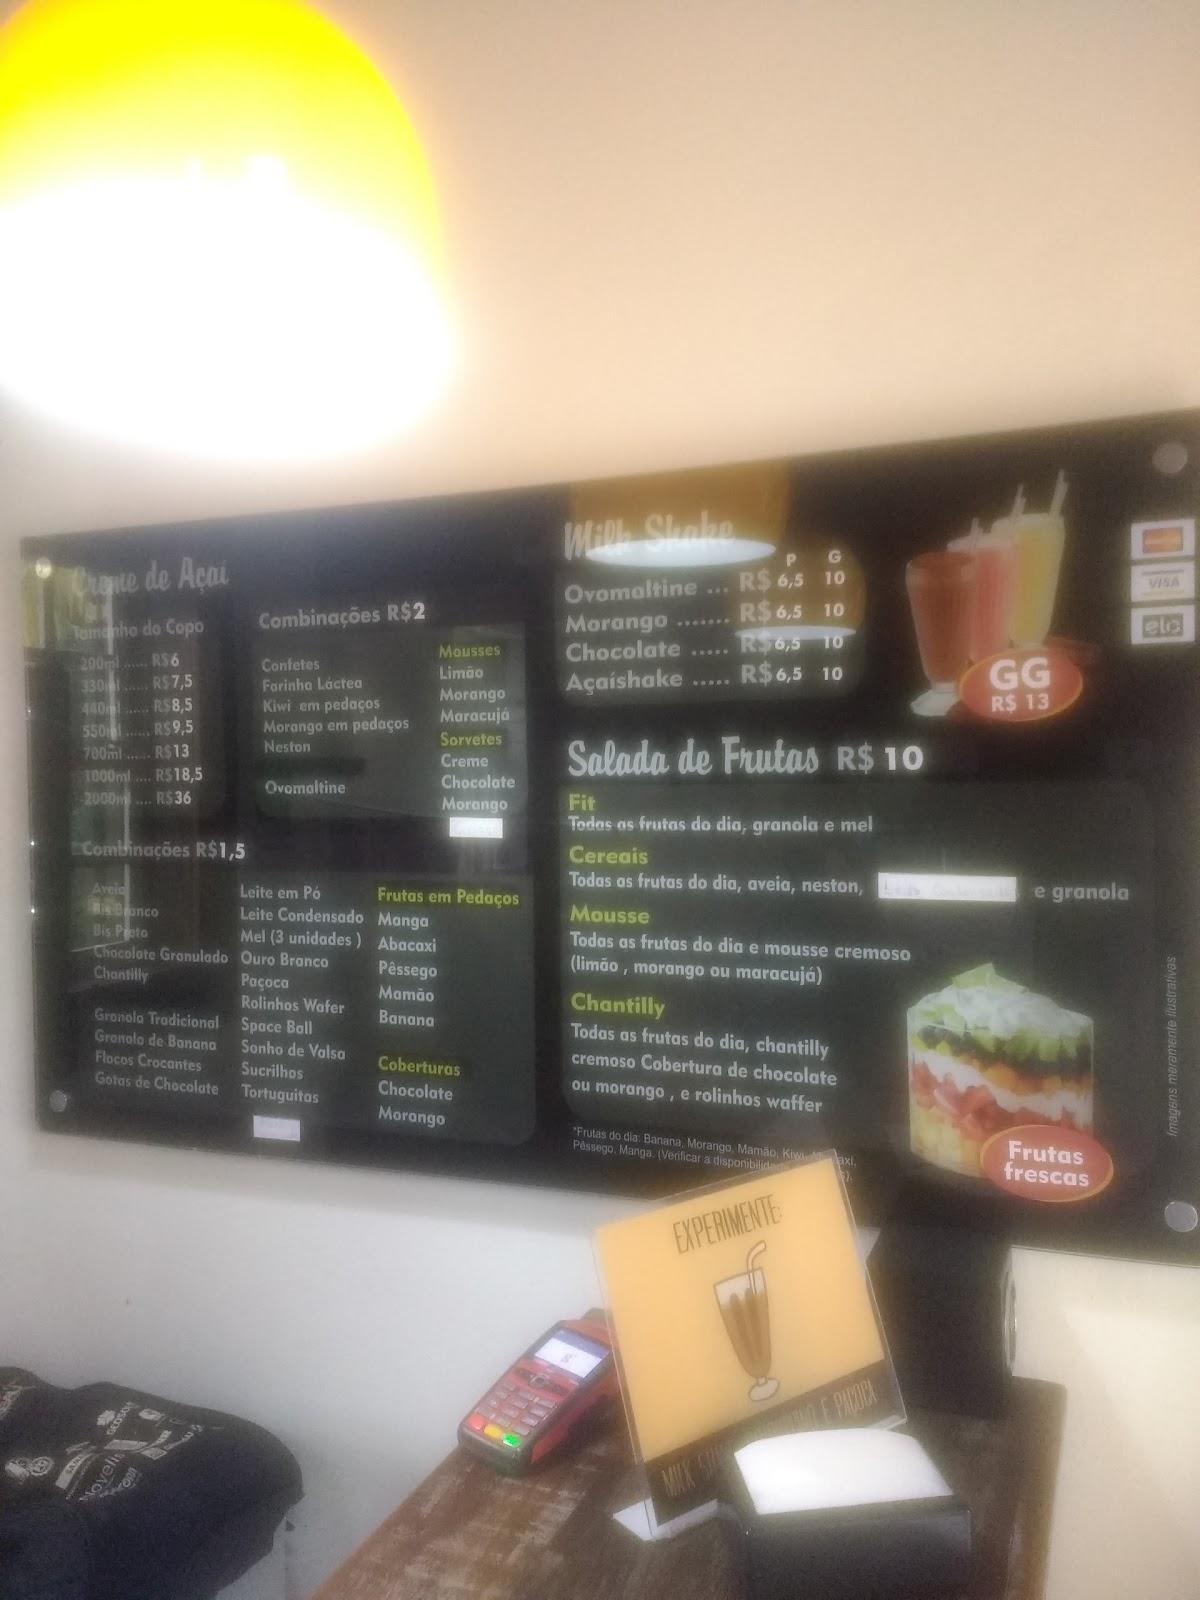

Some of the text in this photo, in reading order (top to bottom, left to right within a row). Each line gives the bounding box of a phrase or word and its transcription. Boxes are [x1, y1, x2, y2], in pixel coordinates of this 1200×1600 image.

[564, 511, 736, 560] Milk Shake
[145, 560, 171, 591] de
[1148, 577, 1180, 589] VISA
[564, 574, 804, 604] Ovomaltine 6,5
[258, 602, 425, 629] Combinações R$2
[565, 605, 802, 636] Morango 6,5
[71, 618, 204, 640] Tamanho do Copo
[439, 644, 501, 659] Mousses
[565, 638, 800, 662] Chocolate 6,5
[80, 653, 179, 671] 200ml R$6
[261, 659, 320, 673] Confetes
[439, 666, 484, 681] Limão
[565, 668, 802, 695] Açaíshake 6,5
[990, 657, 1050, 691] GG
[80, 674, 193, 694] 330ml R$7,5
[262, 677, 313, 693] Farinha
[440, 688, 506, 702] Morango
[991, 693, 1049, 714] R$ 13
[154, 698, 193, 714] R$8,5
[263, 697, 380, 714] Kiwi pedaços
[440, 709, 510, 724] Maracujá
[82, 720, 193, 738] 550ml R$9,5
[264, 718, 409, 735] Morango pedaços
[264, 740, 311, 753] Neston
[440, 732, 502, 746] Sorvetes
[83, 744, 189, 760] 700ml R$13
[441, 753, 489, 768] Creme
[568, 736, 923, 777] Salada Frutas 10
[83, 767, 203, 783] 1000ml R$18,5
[441, 775, 516, 789] Chocolate
[265, 780, 346, 795] Ovomaltine
[156, 790, 191, 805] R$36
[442, 797, 508, 812] Morango
[569, 794, 596, 812] Fit
[568, 815, 873, 836] Todas frutas do dia, granola mel
[82, 840, 245, 862] Combinações R$1,5
[570, 846, 648, 864] Cereais
[241, 885, 273, 899] Leite
[569, 871, 612, 889] Todas
[638, 872, 683, 890] frutas
[713, 874, 742, 893] dia,
[748, 874, 796, 895] aveia,
[802, 876, 864, 897] neston,
[1052, 882, 1129, 903] granola
[378, 887, 520, 908] Frutas Pedaços
[241, 907, 364, 924] Leite Condensado
[378, 913, 429, 930] Manga
[570, 904, 649, 924] Mousse
[94, 924, 111, 937] Bis
[241, 929, 352, 946] Mel unidades
[378, 937, 436, 953] Abacaxi
[570, 931, 911, 961] Todas frutas dia mousse cremoso
[94, 946, 228, 964] Chocolate Granulado
[241, 951, 329, 968] Ouro Branco
[94, 965, 149, 984] Chantilly
[379, 960, 438, 979] Pêssego
[570, 956, 823, 986] (limão morango ou maracujá)
[241, 974, 289, 991] Paçoca
[379, 985, 434, 1002] Mamão
[241, 995, 345, 1014] Rolinhos Wafer
[570, 992, 665, 1020] Chantilly
[95, 1008, 219, 1029] Granola Tradicional
[241, 1017, 312, 1035] Space Ball
[379, 1010, 435, 1027] Banana
[95, 1029, 217, 1051] Granola de Banana
[571, 1023, 829, 1061] Todas frutas do dia, chantilly
[1166, 956, 1180, 1137] Imagens meramente ilustrativas
[241, 1040, 346, 1060] Sonho Valsa
[95, 1051, 202, 1072] Flocos Crocantes
[241, 1062, 304, 1080] Sucrilhos
[378, 1056, 461, 1076] Coberturas
[572, 1053, 837, 1086] cremoso Cobertura de chocolate
[95, 1072, 219, 1095] Gotas Chocolate
[378, 1080, 453, 1101] Chocolate
[242, 1084, 319, 1104] Tortuguitas
[595, 1081, 823, 1113] morango rolinhos waffer
[379, 1105, 446, 1127] Morango
[657, 1148, 701, 1164] (Verificar
[1008, 1141, 1084, 1164] Frutas
[1004, 1162, 1089, 1187] frescas
[672, 1194, 783, 1254] EXPERIMENTE:
